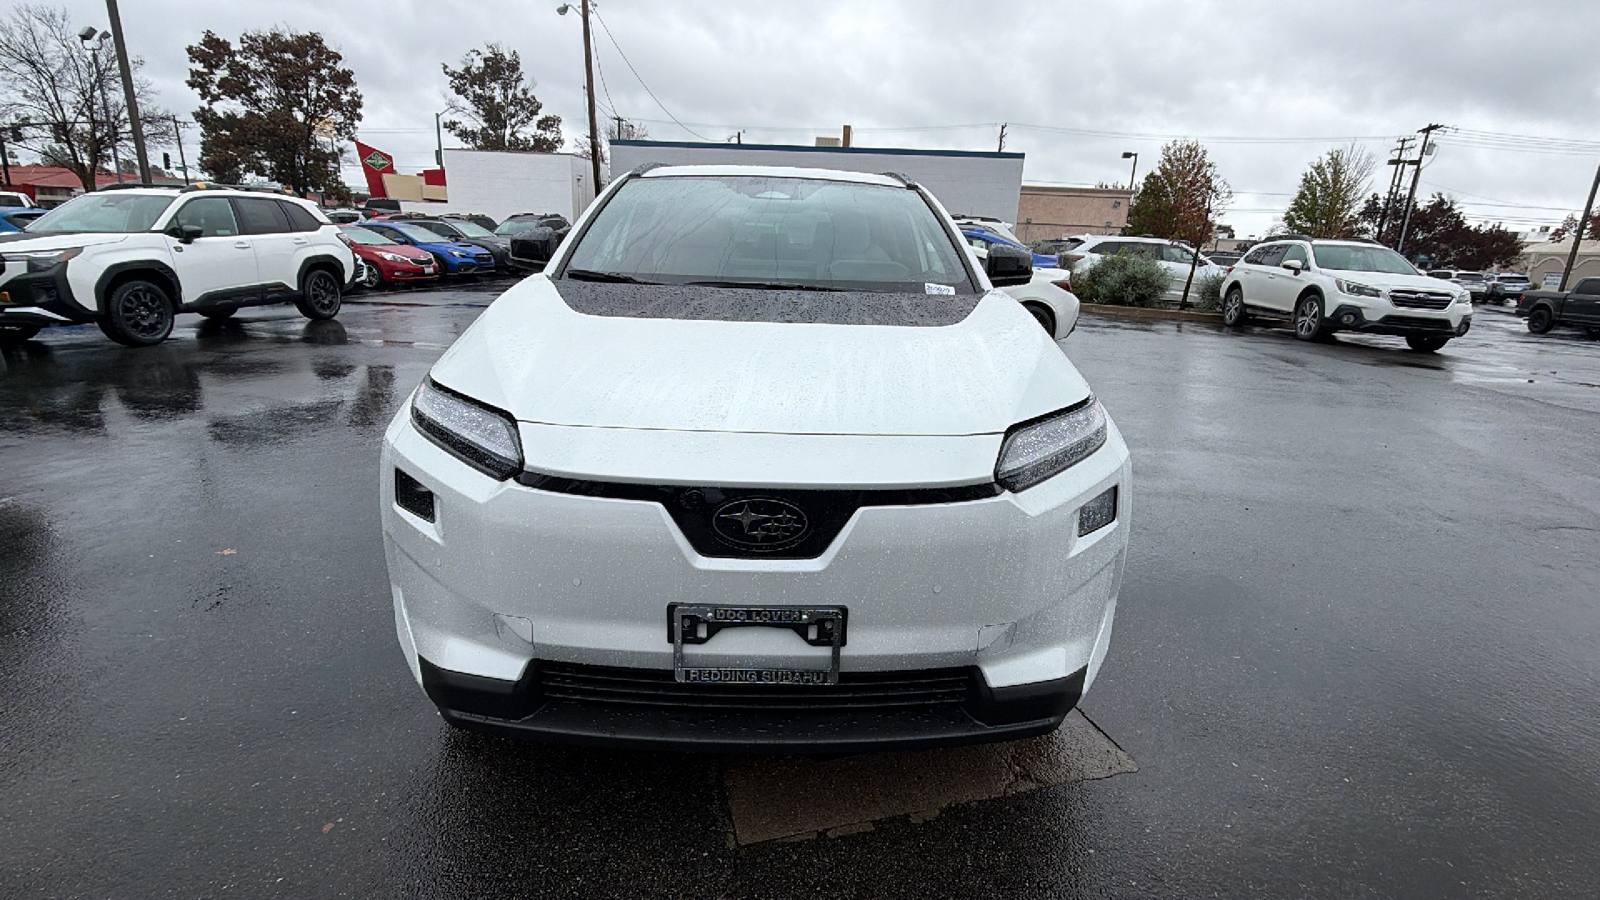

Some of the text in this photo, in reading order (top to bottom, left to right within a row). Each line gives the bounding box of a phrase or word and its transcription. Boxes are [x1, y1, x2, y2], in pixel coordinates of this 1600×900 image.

[716, 610, 800, 621] DOG LOVER
[689, 669, 824, 684] REDDING SUBARU
